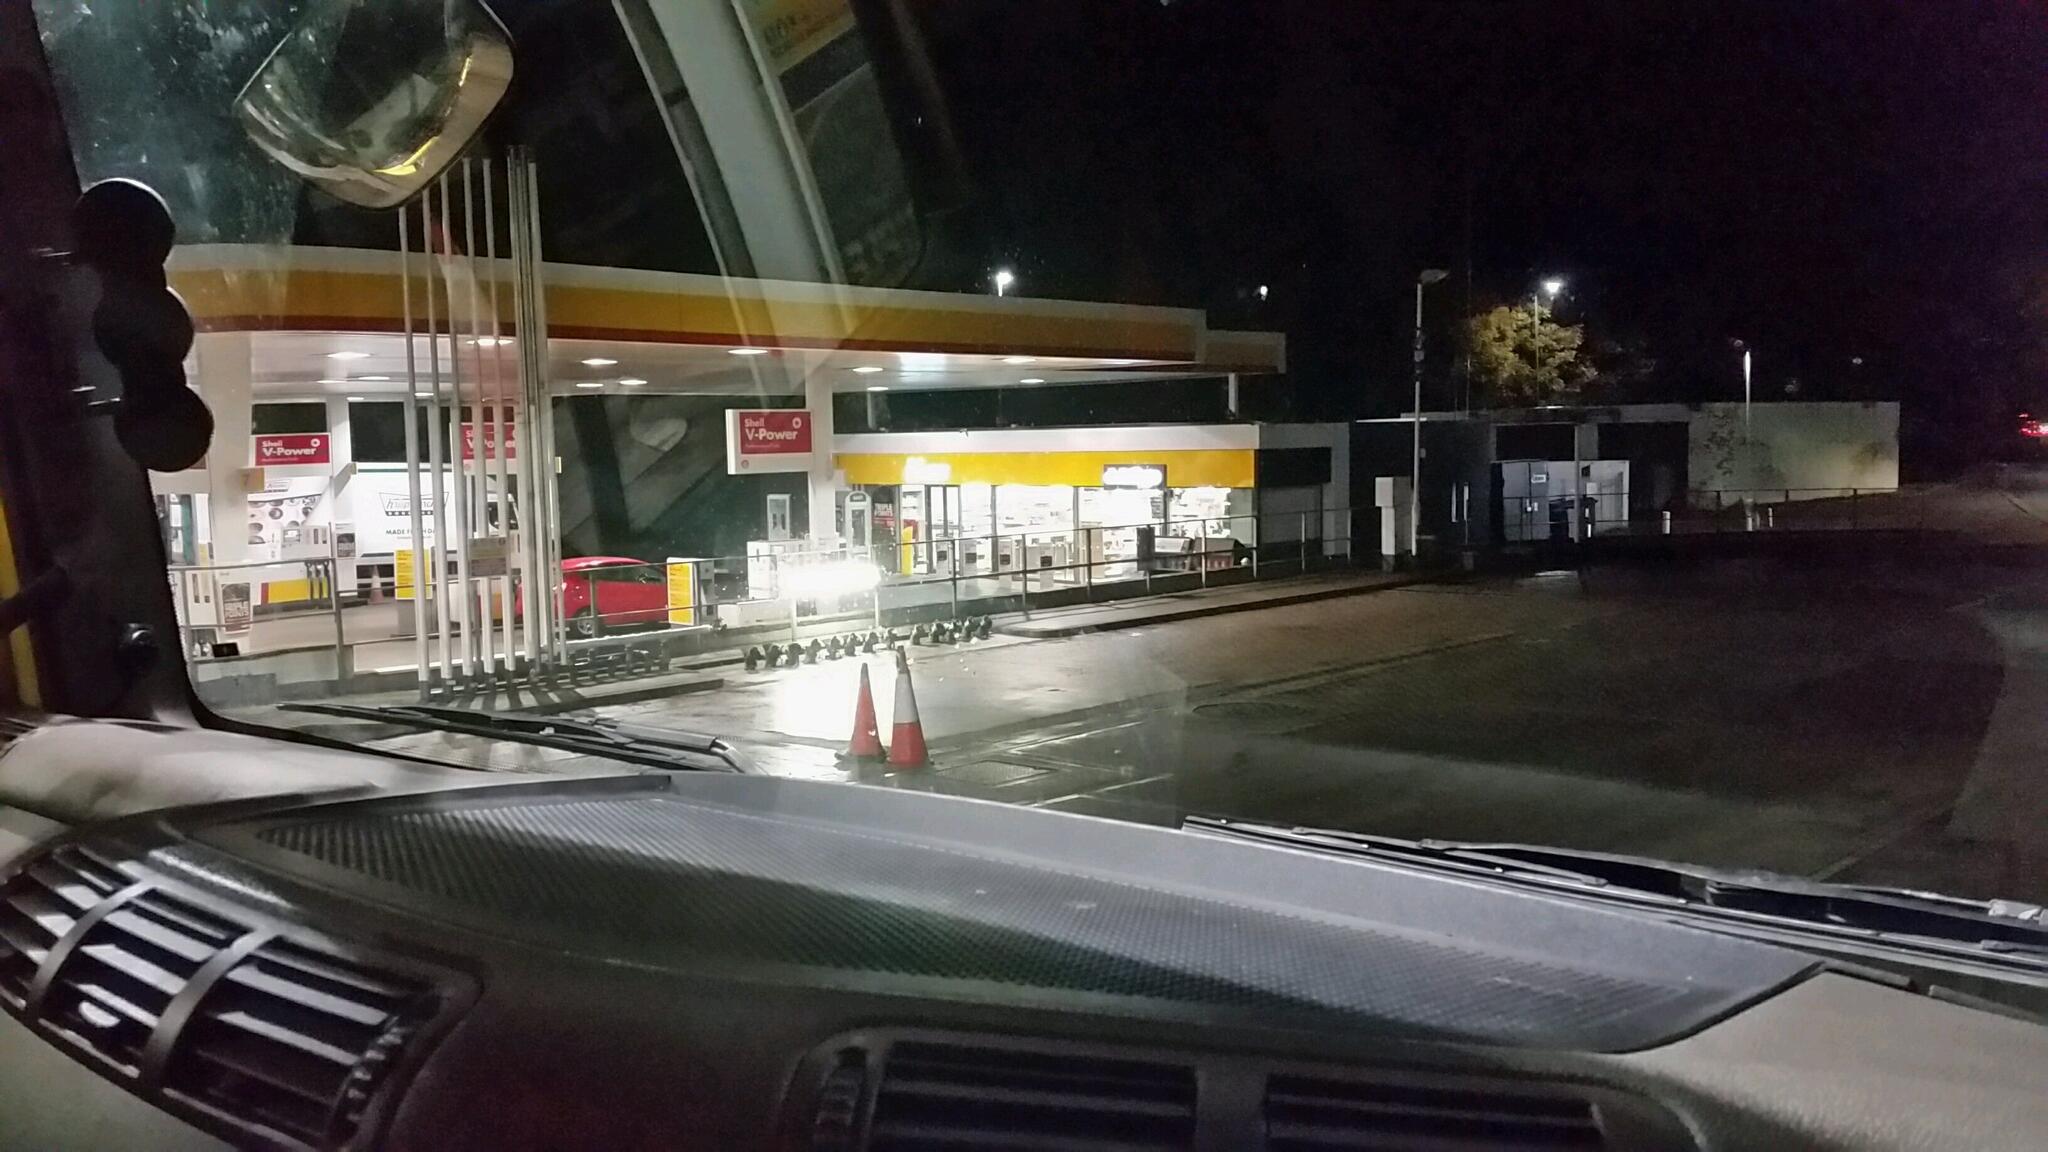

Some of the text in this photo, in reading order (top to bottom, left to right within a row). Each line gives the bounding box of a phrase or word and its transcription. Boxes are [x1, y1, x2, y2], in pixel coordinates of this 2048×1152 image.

[744, 417, 765, 427] Shell
[745, 428, 798, 441] V-Power
[262, 440, 283, 448] Shell
[262, 448, 317, 457] V-Power
